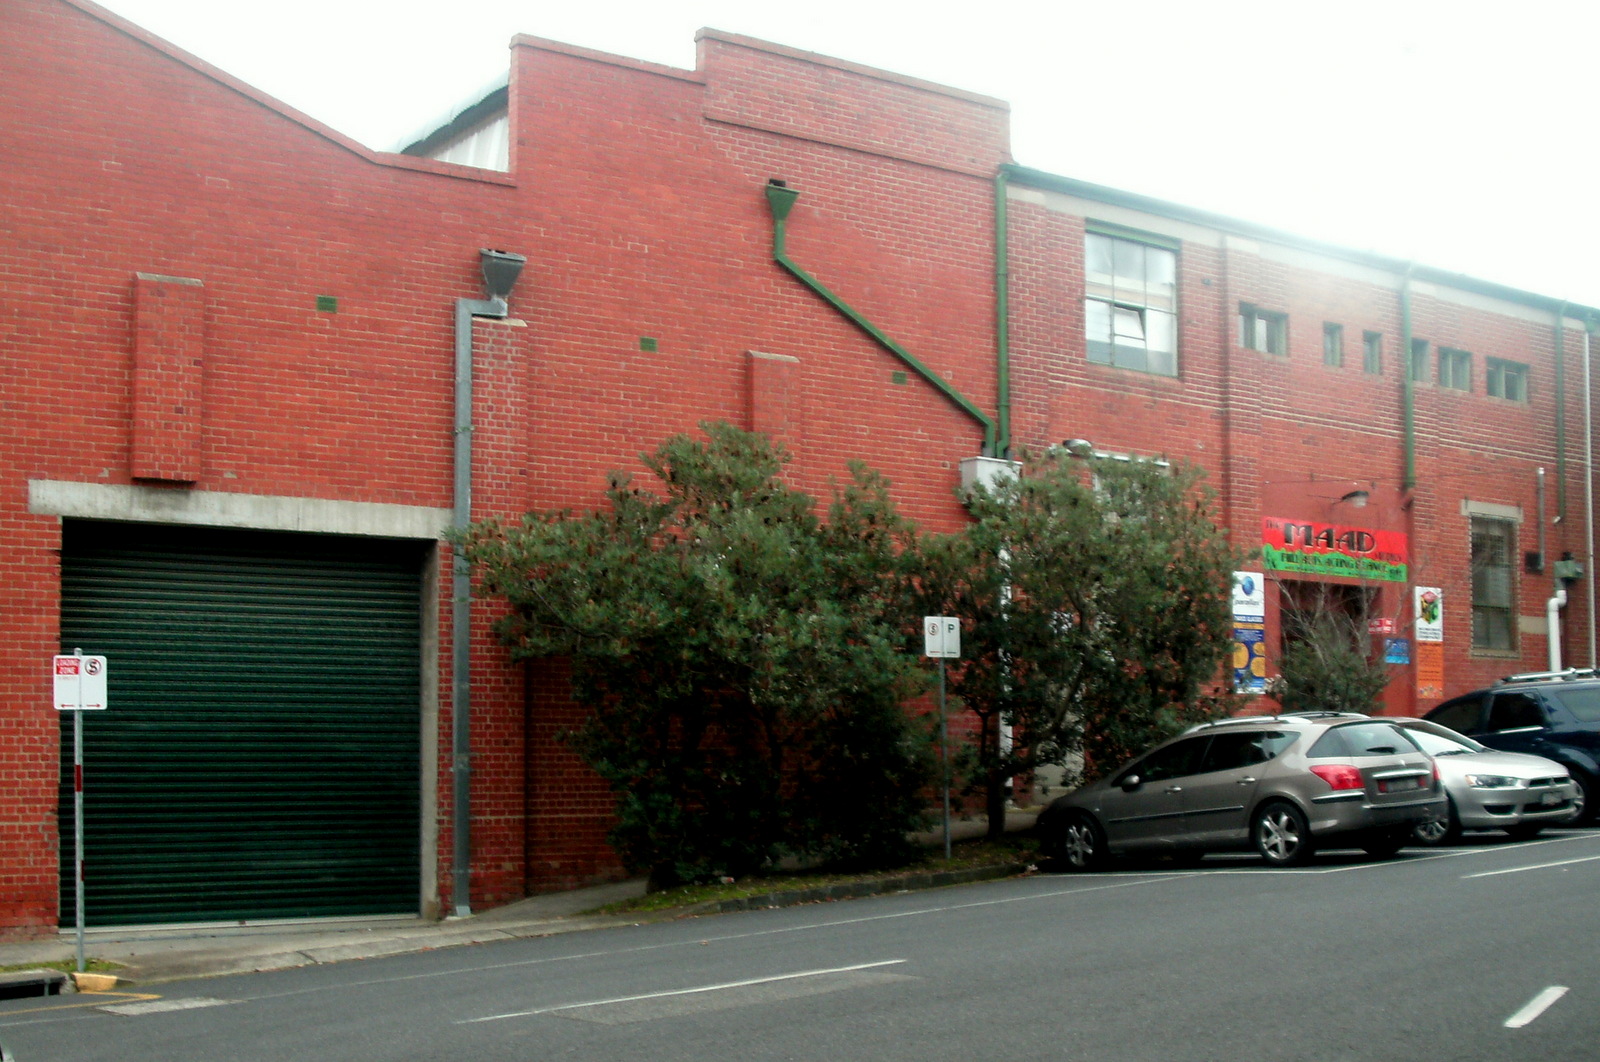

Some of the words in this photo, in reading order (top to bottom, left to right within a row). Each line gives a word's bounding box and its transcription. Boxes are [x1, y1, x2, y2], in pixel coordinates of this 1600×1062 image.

[1284, 523, 1375, 553] MAAD
[948, 623, 955, 633] P
[59, 666, 76, 674] ZONE
